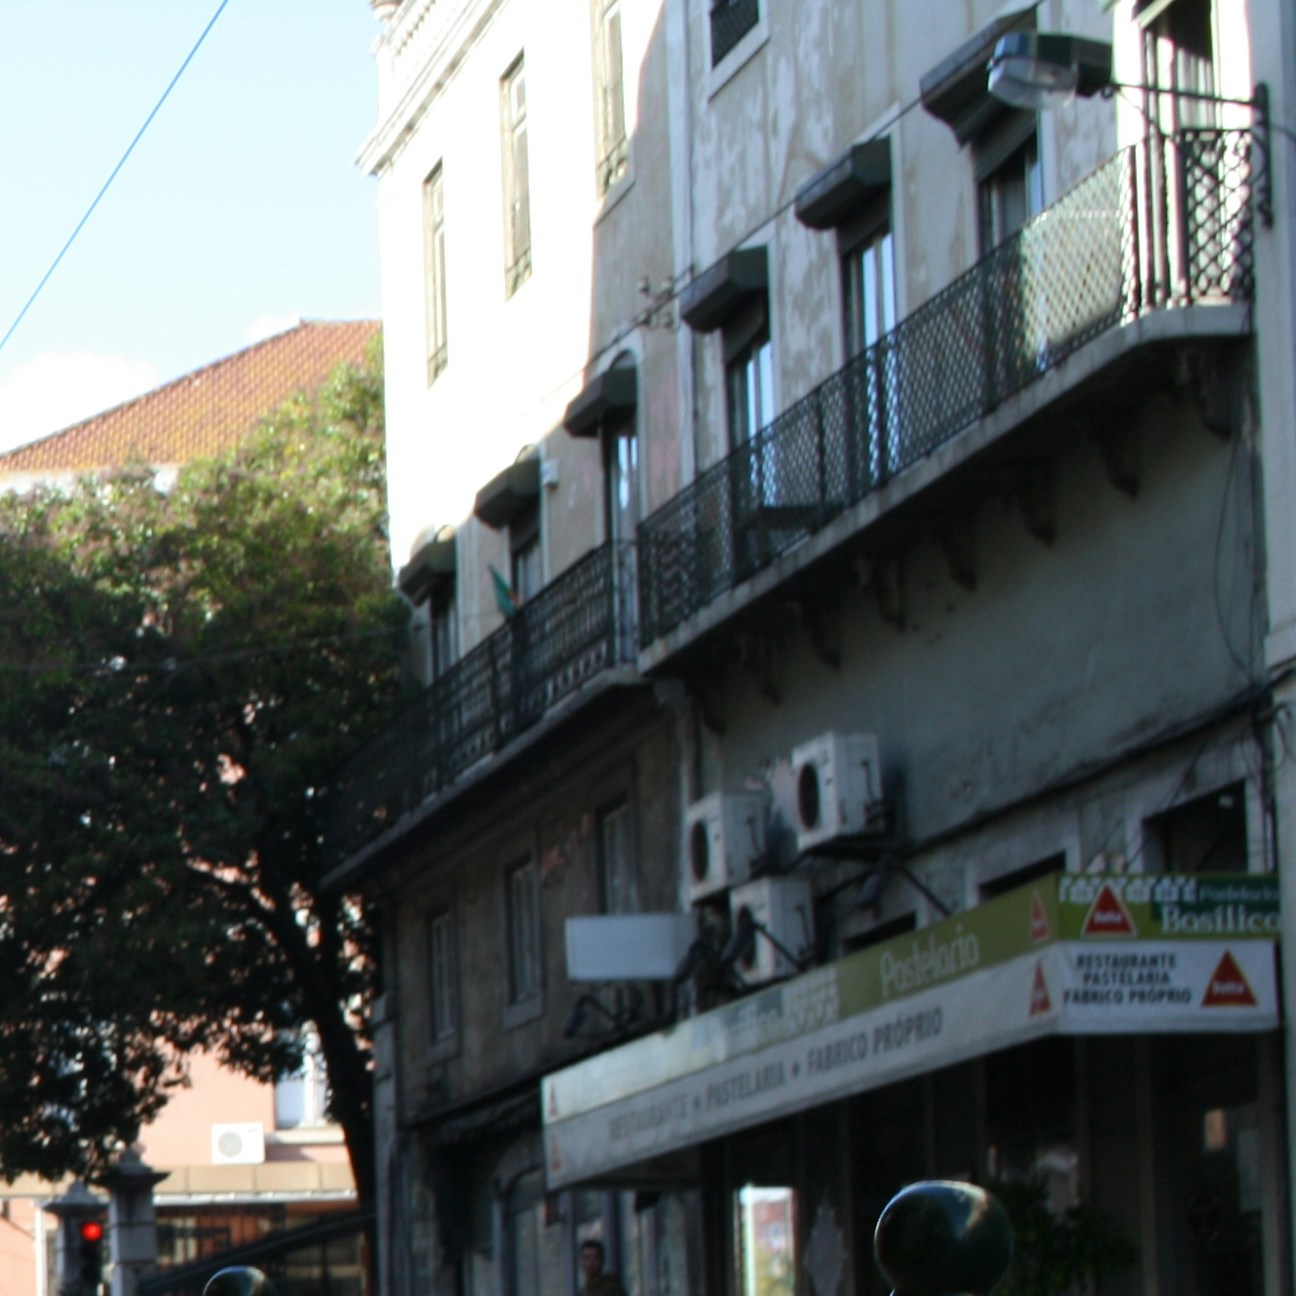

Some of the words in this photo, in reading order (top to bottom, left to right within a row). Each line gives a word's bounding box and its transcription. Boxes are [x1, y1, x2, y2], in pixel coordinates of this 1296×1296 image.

[880, 926, 980, 1000] Pastelaria
[1076, 953, 1177, 970] RESTAURANTE
[1083, 971, 1171, 986] PASTELARIA
[1063, 989, 1124, 1004] FABRICO
[1128, 987, 1192, 1004] PRÓPRIO
[705, 1062, 786, 1110] PASTELARIA
[807, 1029, 868, 1073] FABRICO
[872, 1006, 943, 1056] PRÓPRIO
